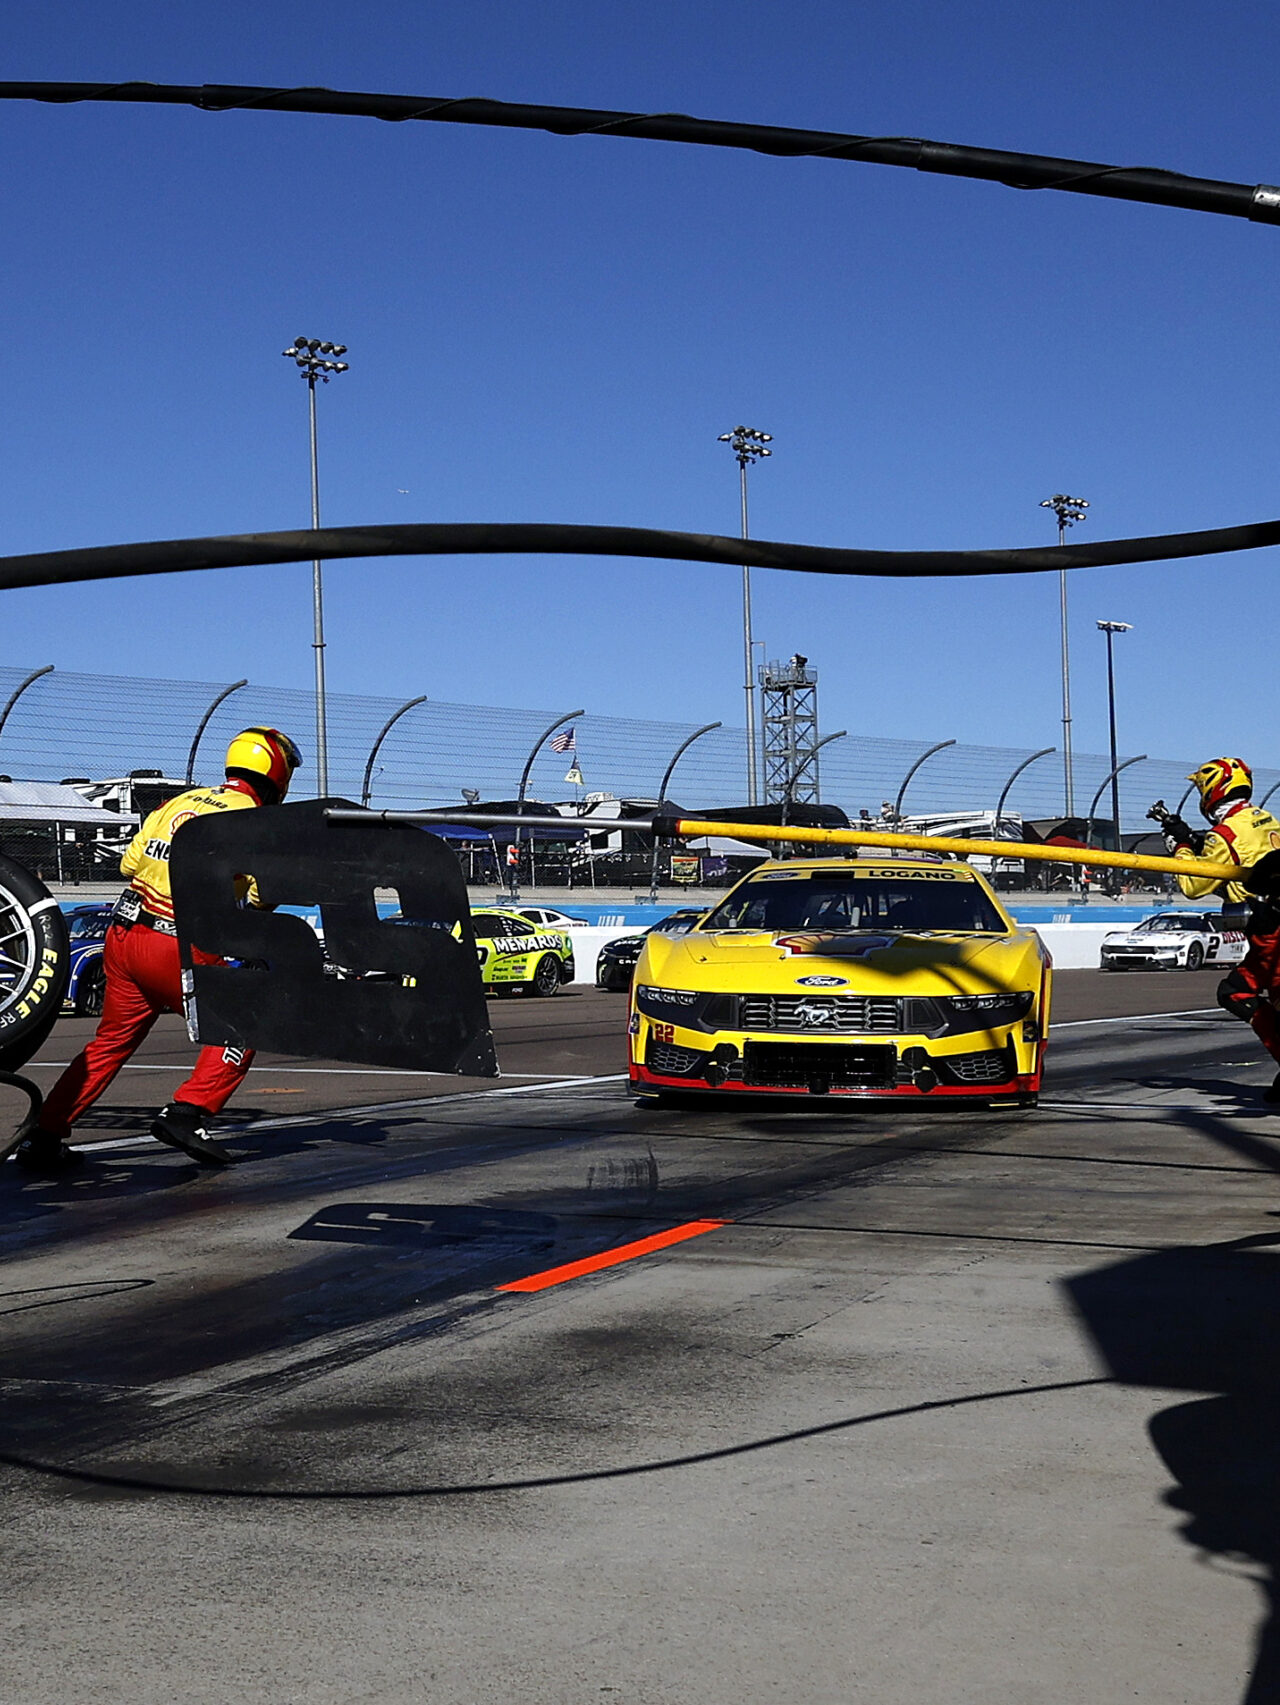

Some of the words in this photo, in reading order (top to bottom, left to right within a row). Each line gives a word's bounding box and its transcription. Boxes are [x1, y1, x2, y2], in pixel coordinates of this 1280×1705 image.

[869, 869, 956, 880] LOGANO
[493, 935, 563, 956] MENARDS
[1206, 936, 1220, 959] 2
[15, 946, 59, 1020] EAGLE
[802, 975, 842, 987] Ford
[654, 1023, 676, 1043] 22
